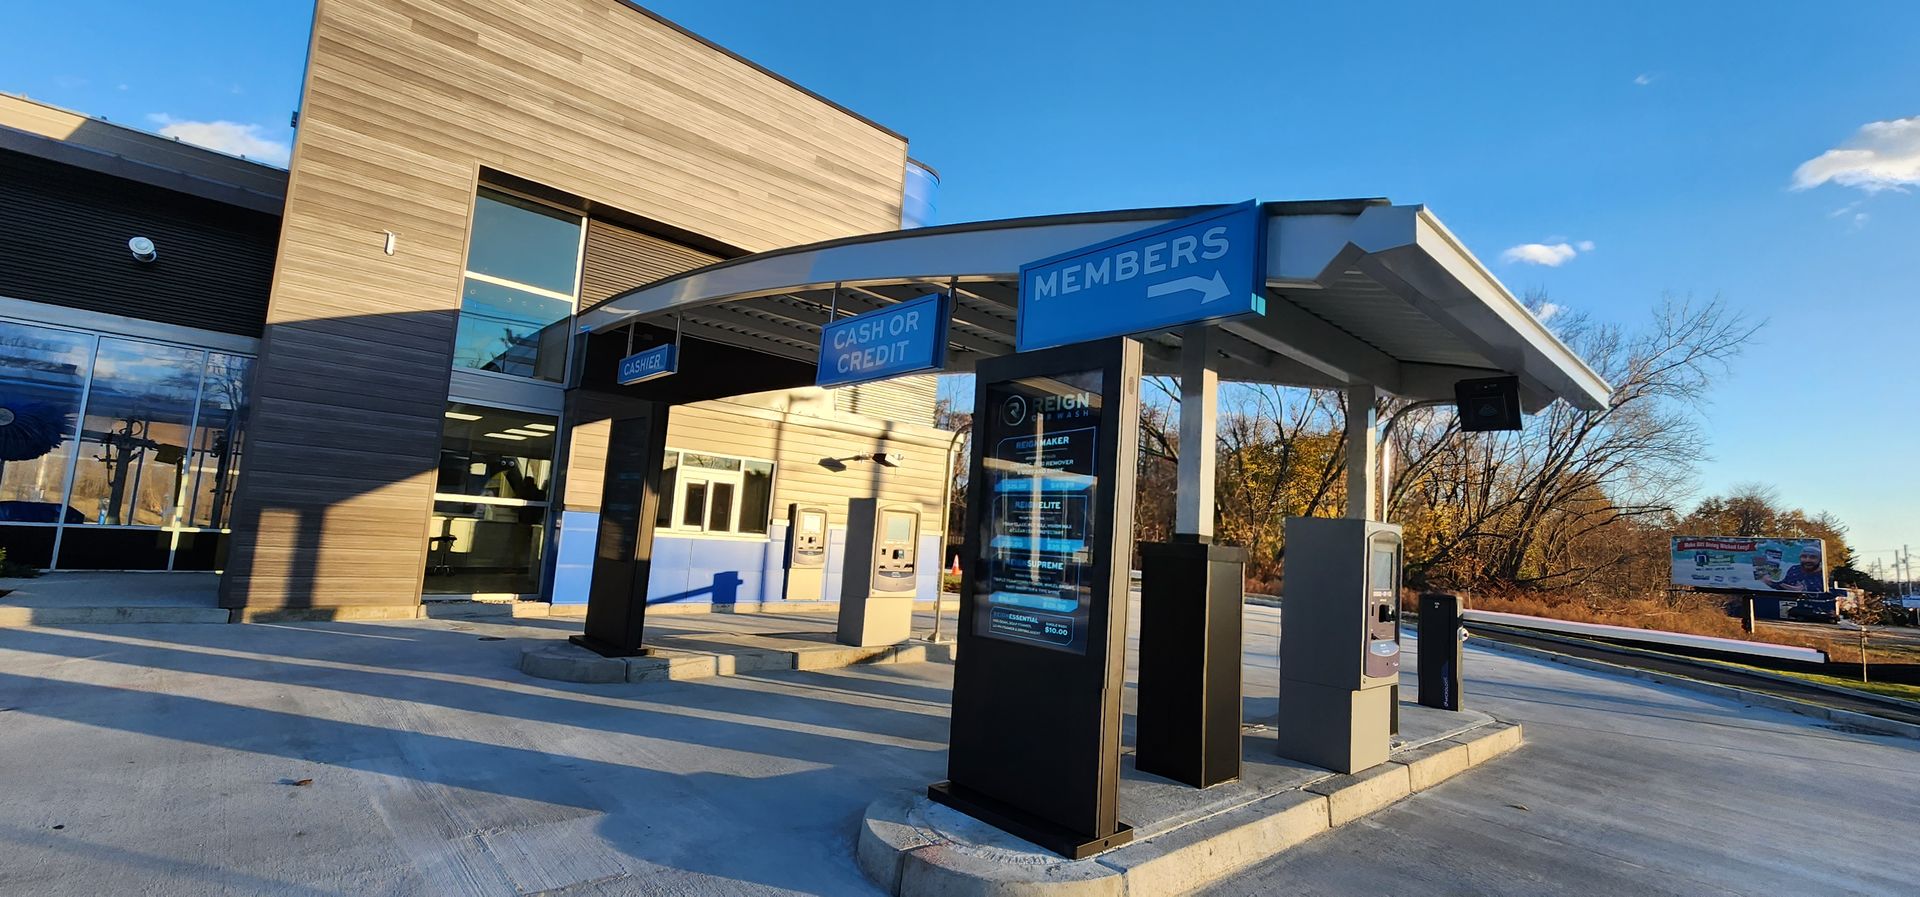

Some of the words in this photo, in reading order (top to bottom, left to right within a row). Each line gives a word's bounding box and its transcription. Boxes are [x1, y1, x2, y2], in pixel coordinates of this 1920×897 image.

[1034, 226, 1230, 301] MEMBERS
[834, 320, 885, 350] CASH
[889, 311, 920, 337] OR
[623, 354, 661, 376] CASHIER
[837, 340, 900, 374] CREDIT
[1033, 392, 1090, 413] REIGN
[1032, 412, 1052, 422] CR
[1057, 410, 1090, 420] WASH
[1045, 626, 1068, 636] $10.00
